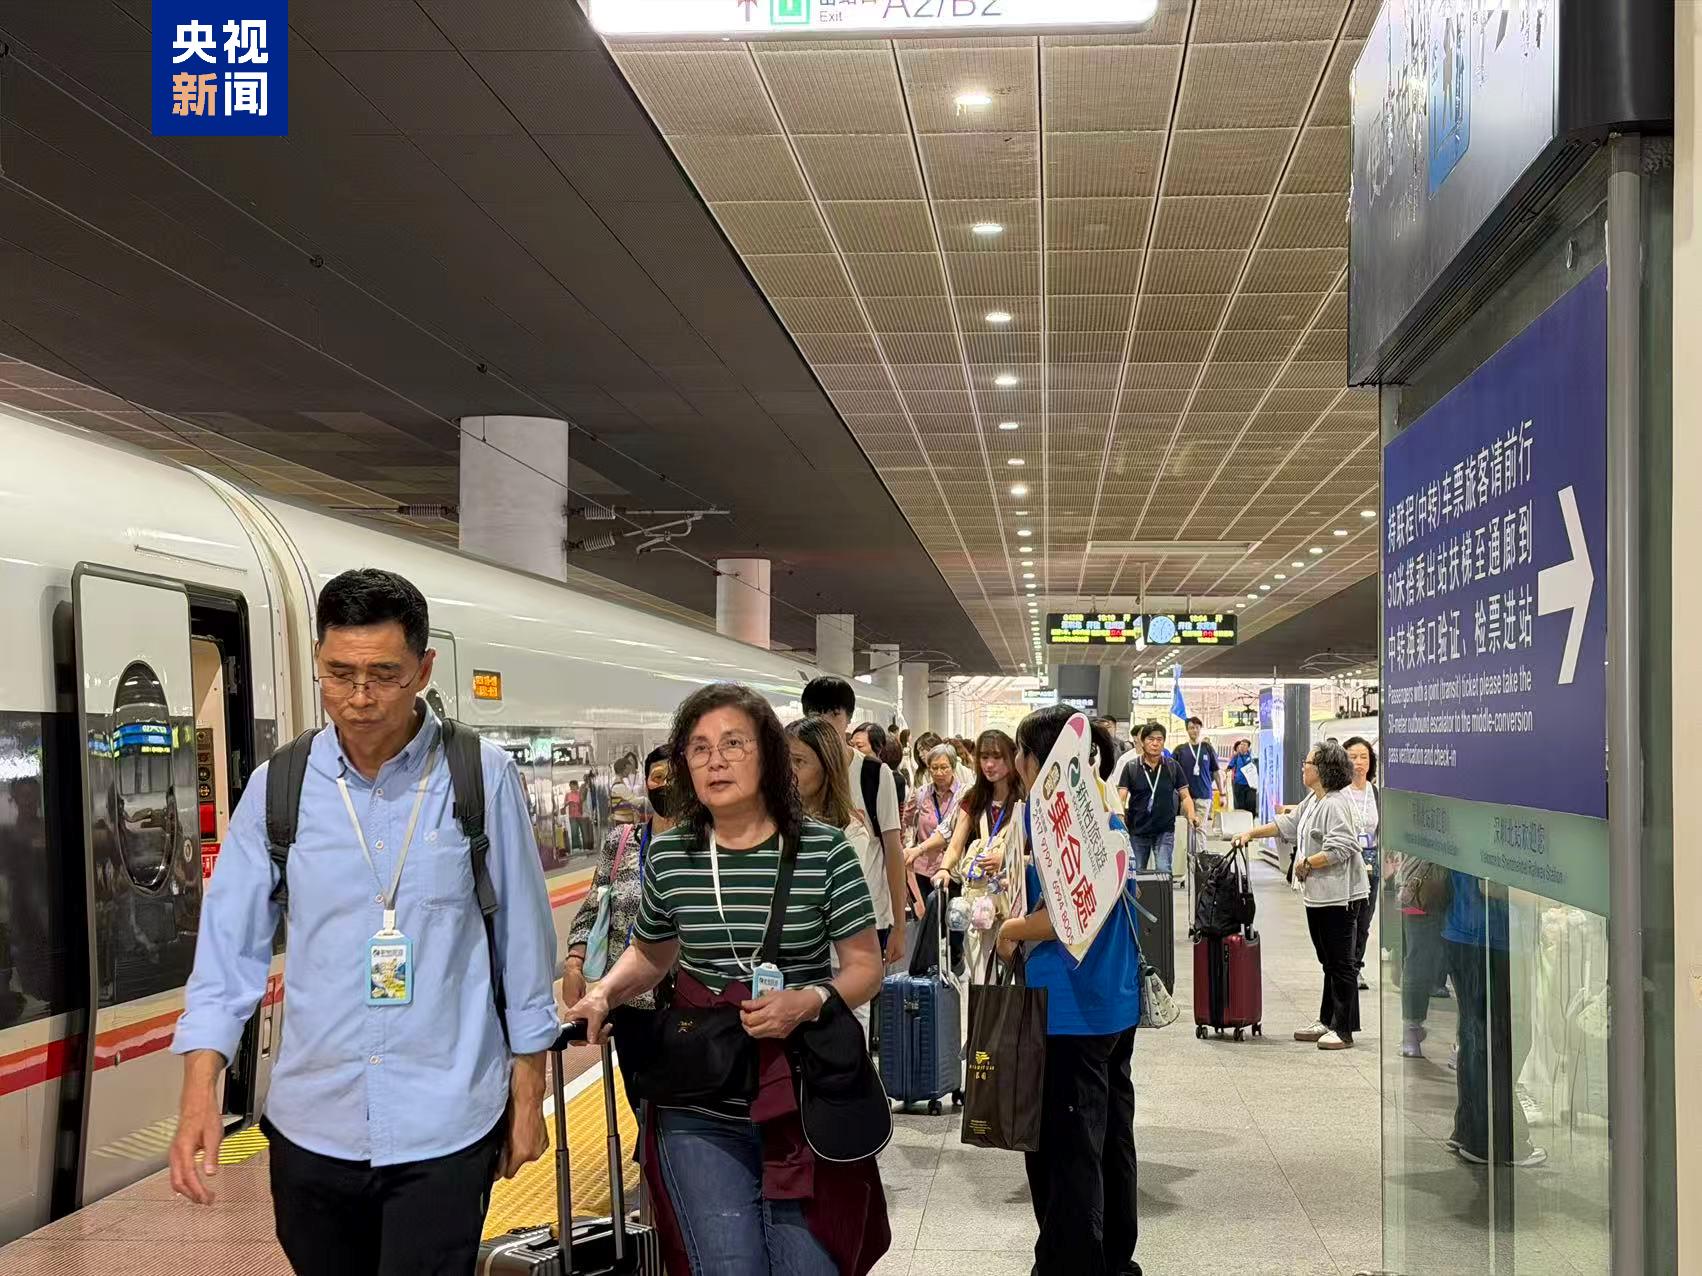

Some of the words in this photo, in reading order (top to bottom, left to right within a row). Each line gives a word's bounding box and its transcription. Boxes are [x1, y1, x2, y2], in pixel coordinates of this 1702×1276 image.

[820, 11, 843, 22] Exit
[883, 0, 1002, 18] A2/B2
[1387, 419, 1534, 553] 持联程(中转)车票旅客请前行
[1387, 499, 1533, 609] 50米搭乘出站扶梯至通廊到
[1461, 673, 1479, 697] ticket
[1480, 670, 1501, 703] please
[1502, 667, 1518, 693] take
[1520, 664, 1532, 691] the
[1454, 710, 1461, 732] to
[1461, 708, 1471, 732] the
[1471, 704, 1533, 732] middle-conversion
[1434, 744, 1457, 767] check-in
[1048, 791, 1097, 934] 集合處
[1061, 910, 1074, 946] 8005
